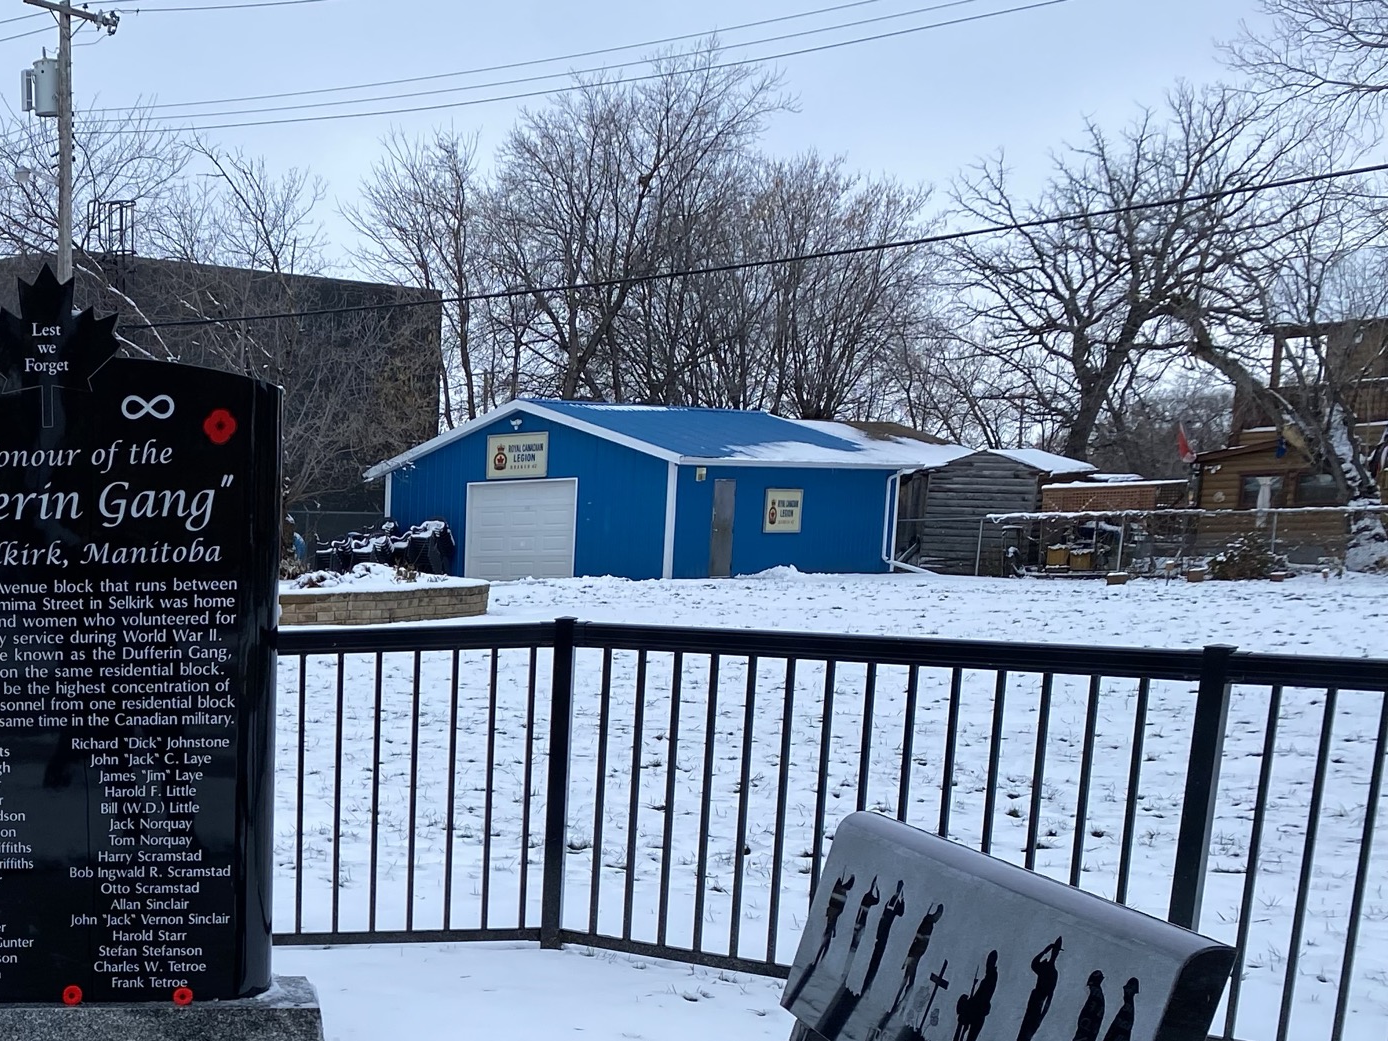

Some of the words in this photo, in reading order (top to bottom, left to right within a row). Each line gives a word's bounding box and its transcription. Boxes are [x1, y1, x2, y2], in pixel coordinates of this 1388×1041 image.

[32, 322, 61, 336] Lest
[37, 344, 56, 354] we
[24, 358, 68, 376] Forget
[91, 440, 123, 474] of
[130, 439, 172, 464] the
[513, 453, 536, 463] LEGION
[80, 538, 222, 564] Manitoba
[54, 579, 93, 593] block
[100, 578, 128, 592] that
[136, 582, 166, 592] runs
[173, 577, 237, 591] between
[22, 617, 77, 627] women
[83, 613, 115, 626] who
[121, 611, 209, 626] volunteered
[216, 610, 236, 624] for
[14, 648, 63, 661] known
[70, 650, 86, 660] as
[92, 646, 116, 660] the
[122, 646, 182, 660] Dufferin
[188, 645, 232, 662] Gang,
[4, 682, 21, 695] be
[28, 681, 50, 694] the
[56, 680, 106, 698] highest
[112, 680, 209, 694] concentration
[215, 678, 230, 692] of
[72, 737, 118, 750] Richard
[166, 736, 230, 750] Johnstone
[90, 753, 118, 768] John
[164, 752, 179, 764] C.
[184, 752, 212, 766] Laye
[98, 770, 136, 784] James
[176, 769, 203, 783] Laye
[105, 785, 146, 797] Harold
[151, 785, 161, 796] F.
[166, 784, 196, 796] Little
[101, 802, 118, 814] Bill
[170, 801, 200, 813] Little
[109, 818, 134, 832] Jack
[140, 818, 192, 832] Norquay
[98, 851, 132, 864] Harry
[138, 849, 202, 862] Scramstad
[70, 866, 94, 878] Bob
[98, 866, 145, 881] Ingwald
[150, 866, 162, 877] R.
[168, 864, 231, 878] Scramstad
[101, 883, 130, 894] Otto
[136, 882, 200, 894] Scramstad
[110, 898, 141, 910] Allan
[146, 898, 189, 910] Sinclair
[70, 914, 97, 927] John
[141, 914, 183, 925] Vernon
[188, 912, 230, 924] Sinclair
[113, 930, 153, 941] Harold
[158, 930, 187, 941] Starr
[99, 945, 137, 956] Stefan
[142, 944, 202, 956] Stefanson
[94, 960, 140, 972] Charles
[144, 961, 163, 972] W.
[168, 961, 206, 972] Tetroe
[112, 976, 144, 988] Frank
[148, 976, 188, 988] Tetroe
